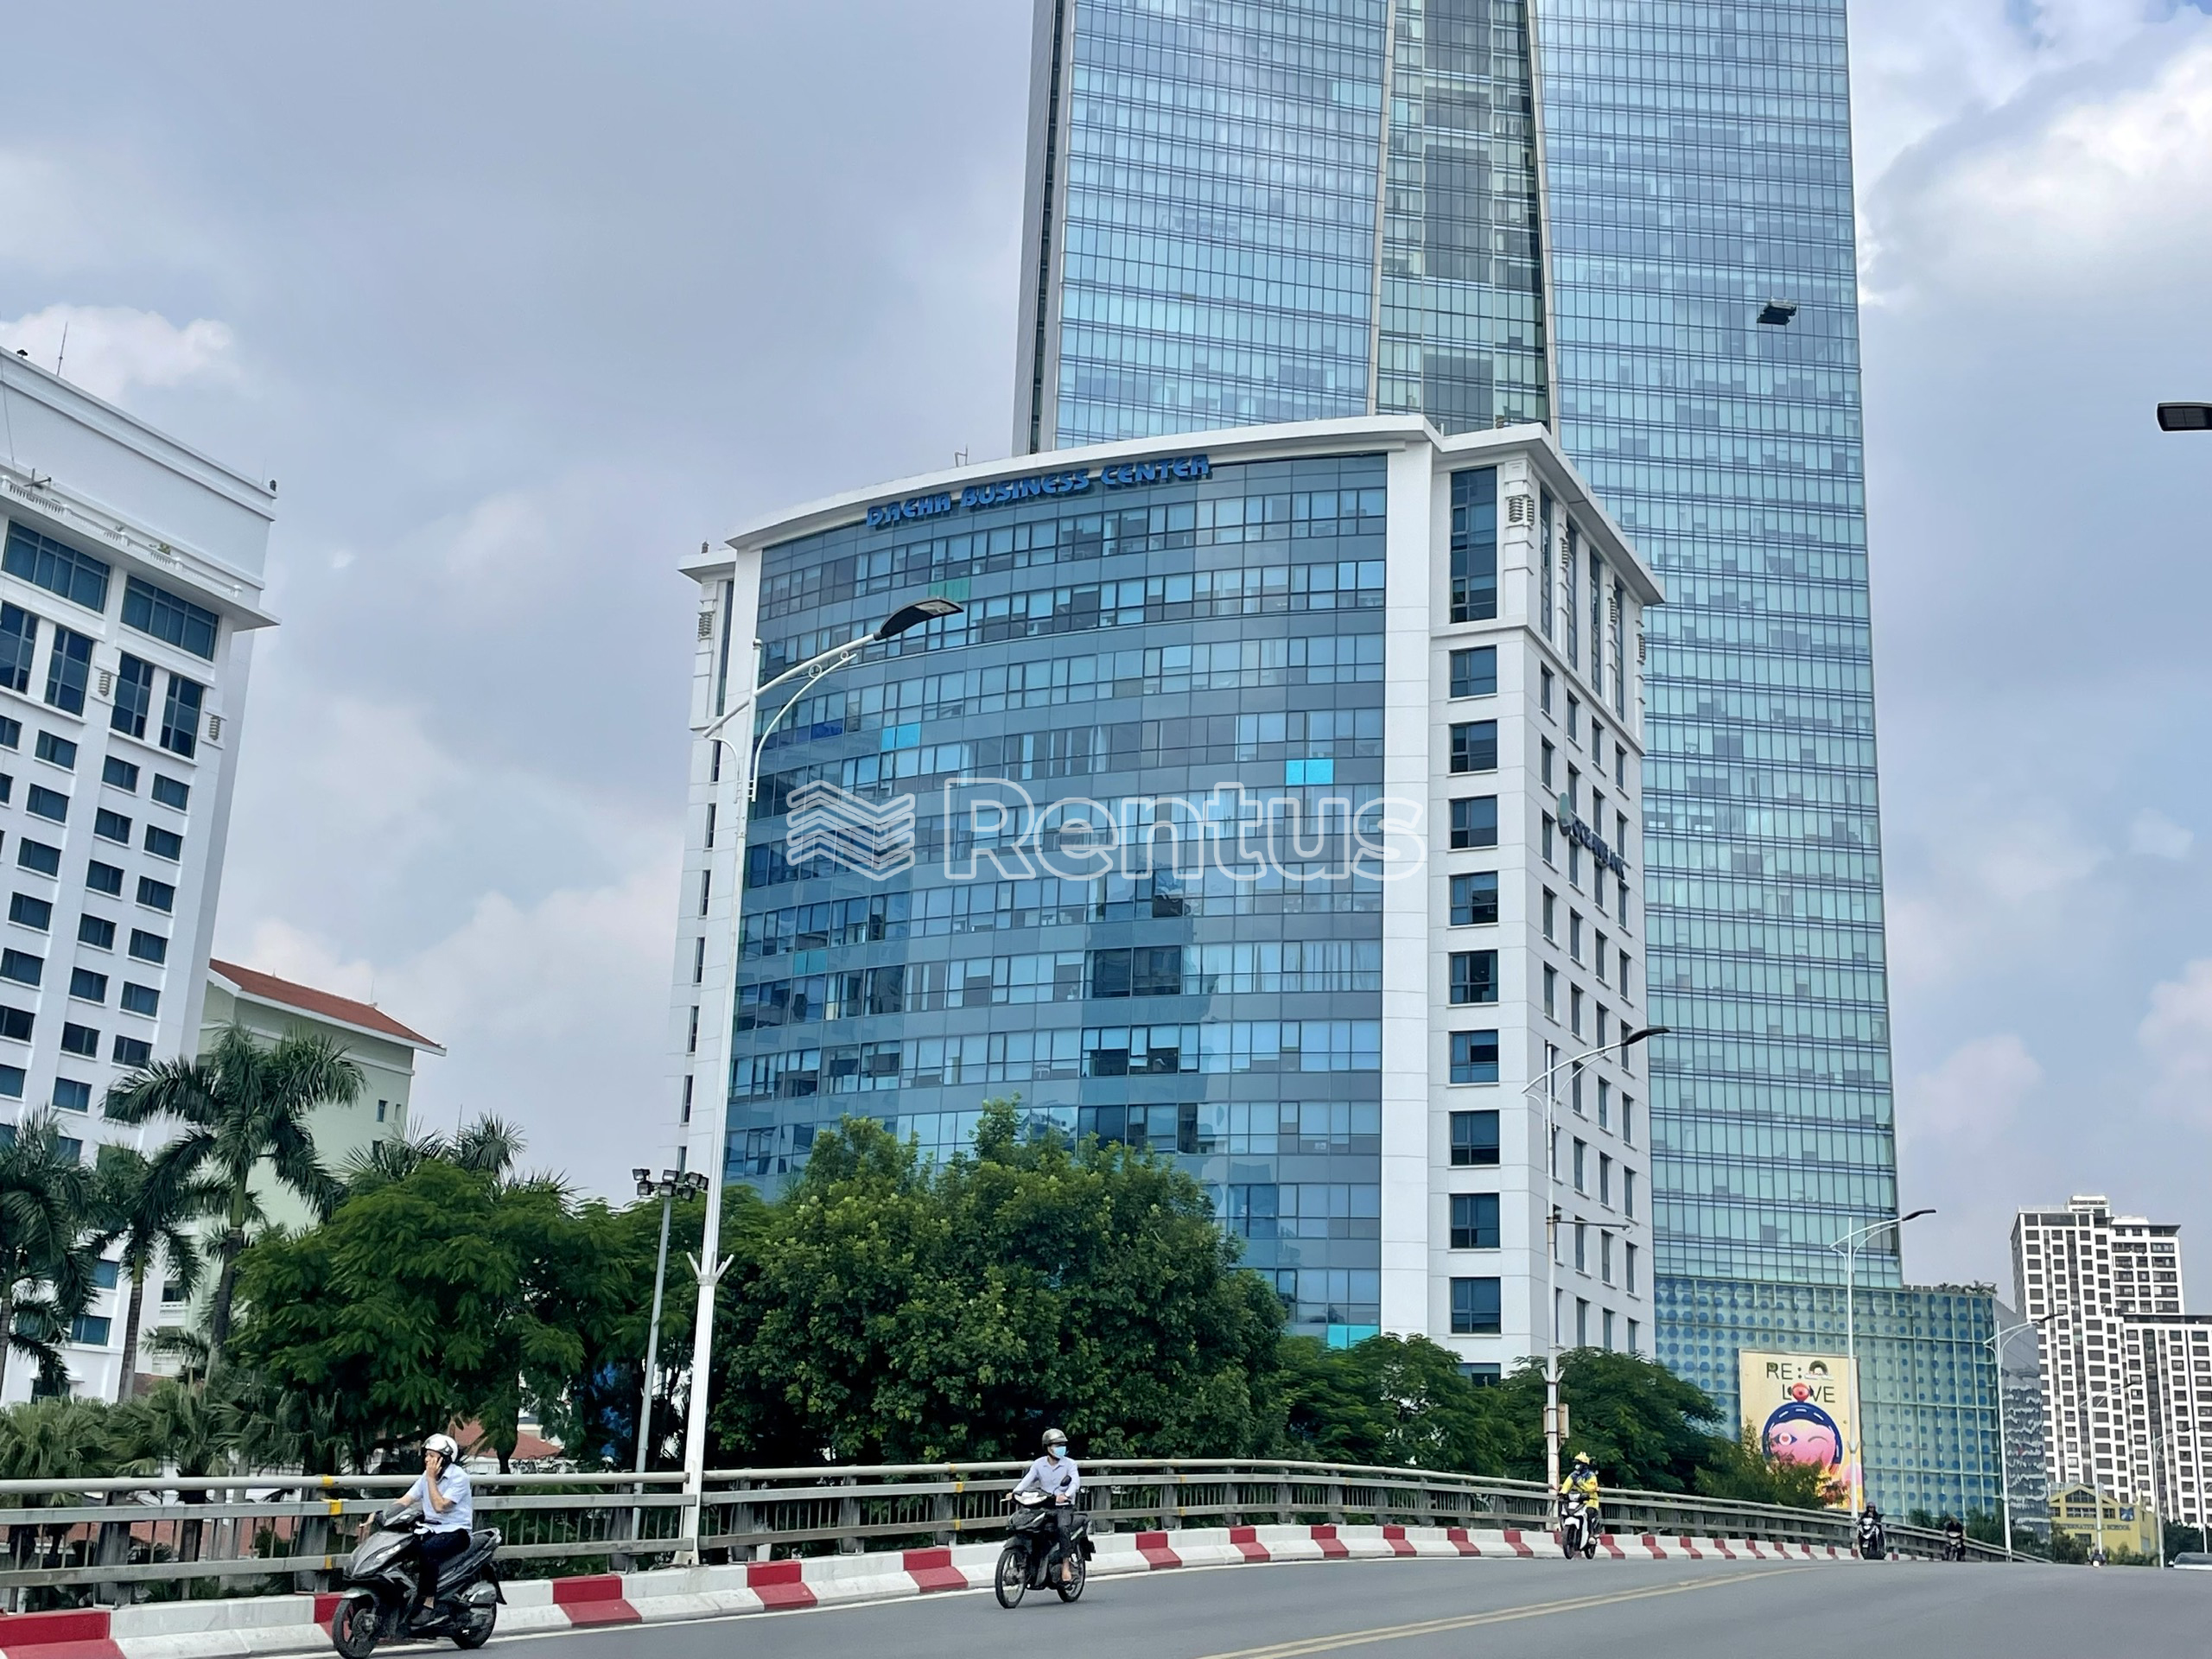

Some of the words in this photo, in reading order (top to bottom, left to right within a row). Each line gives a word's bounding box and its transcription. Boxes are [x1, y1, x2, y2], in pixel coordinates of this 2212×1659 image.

[867, 491, 951, 527] DAEHA
[960, 468, 1090, 507] BUSINESS
[1101, 454, 1210, 485] CENTER
